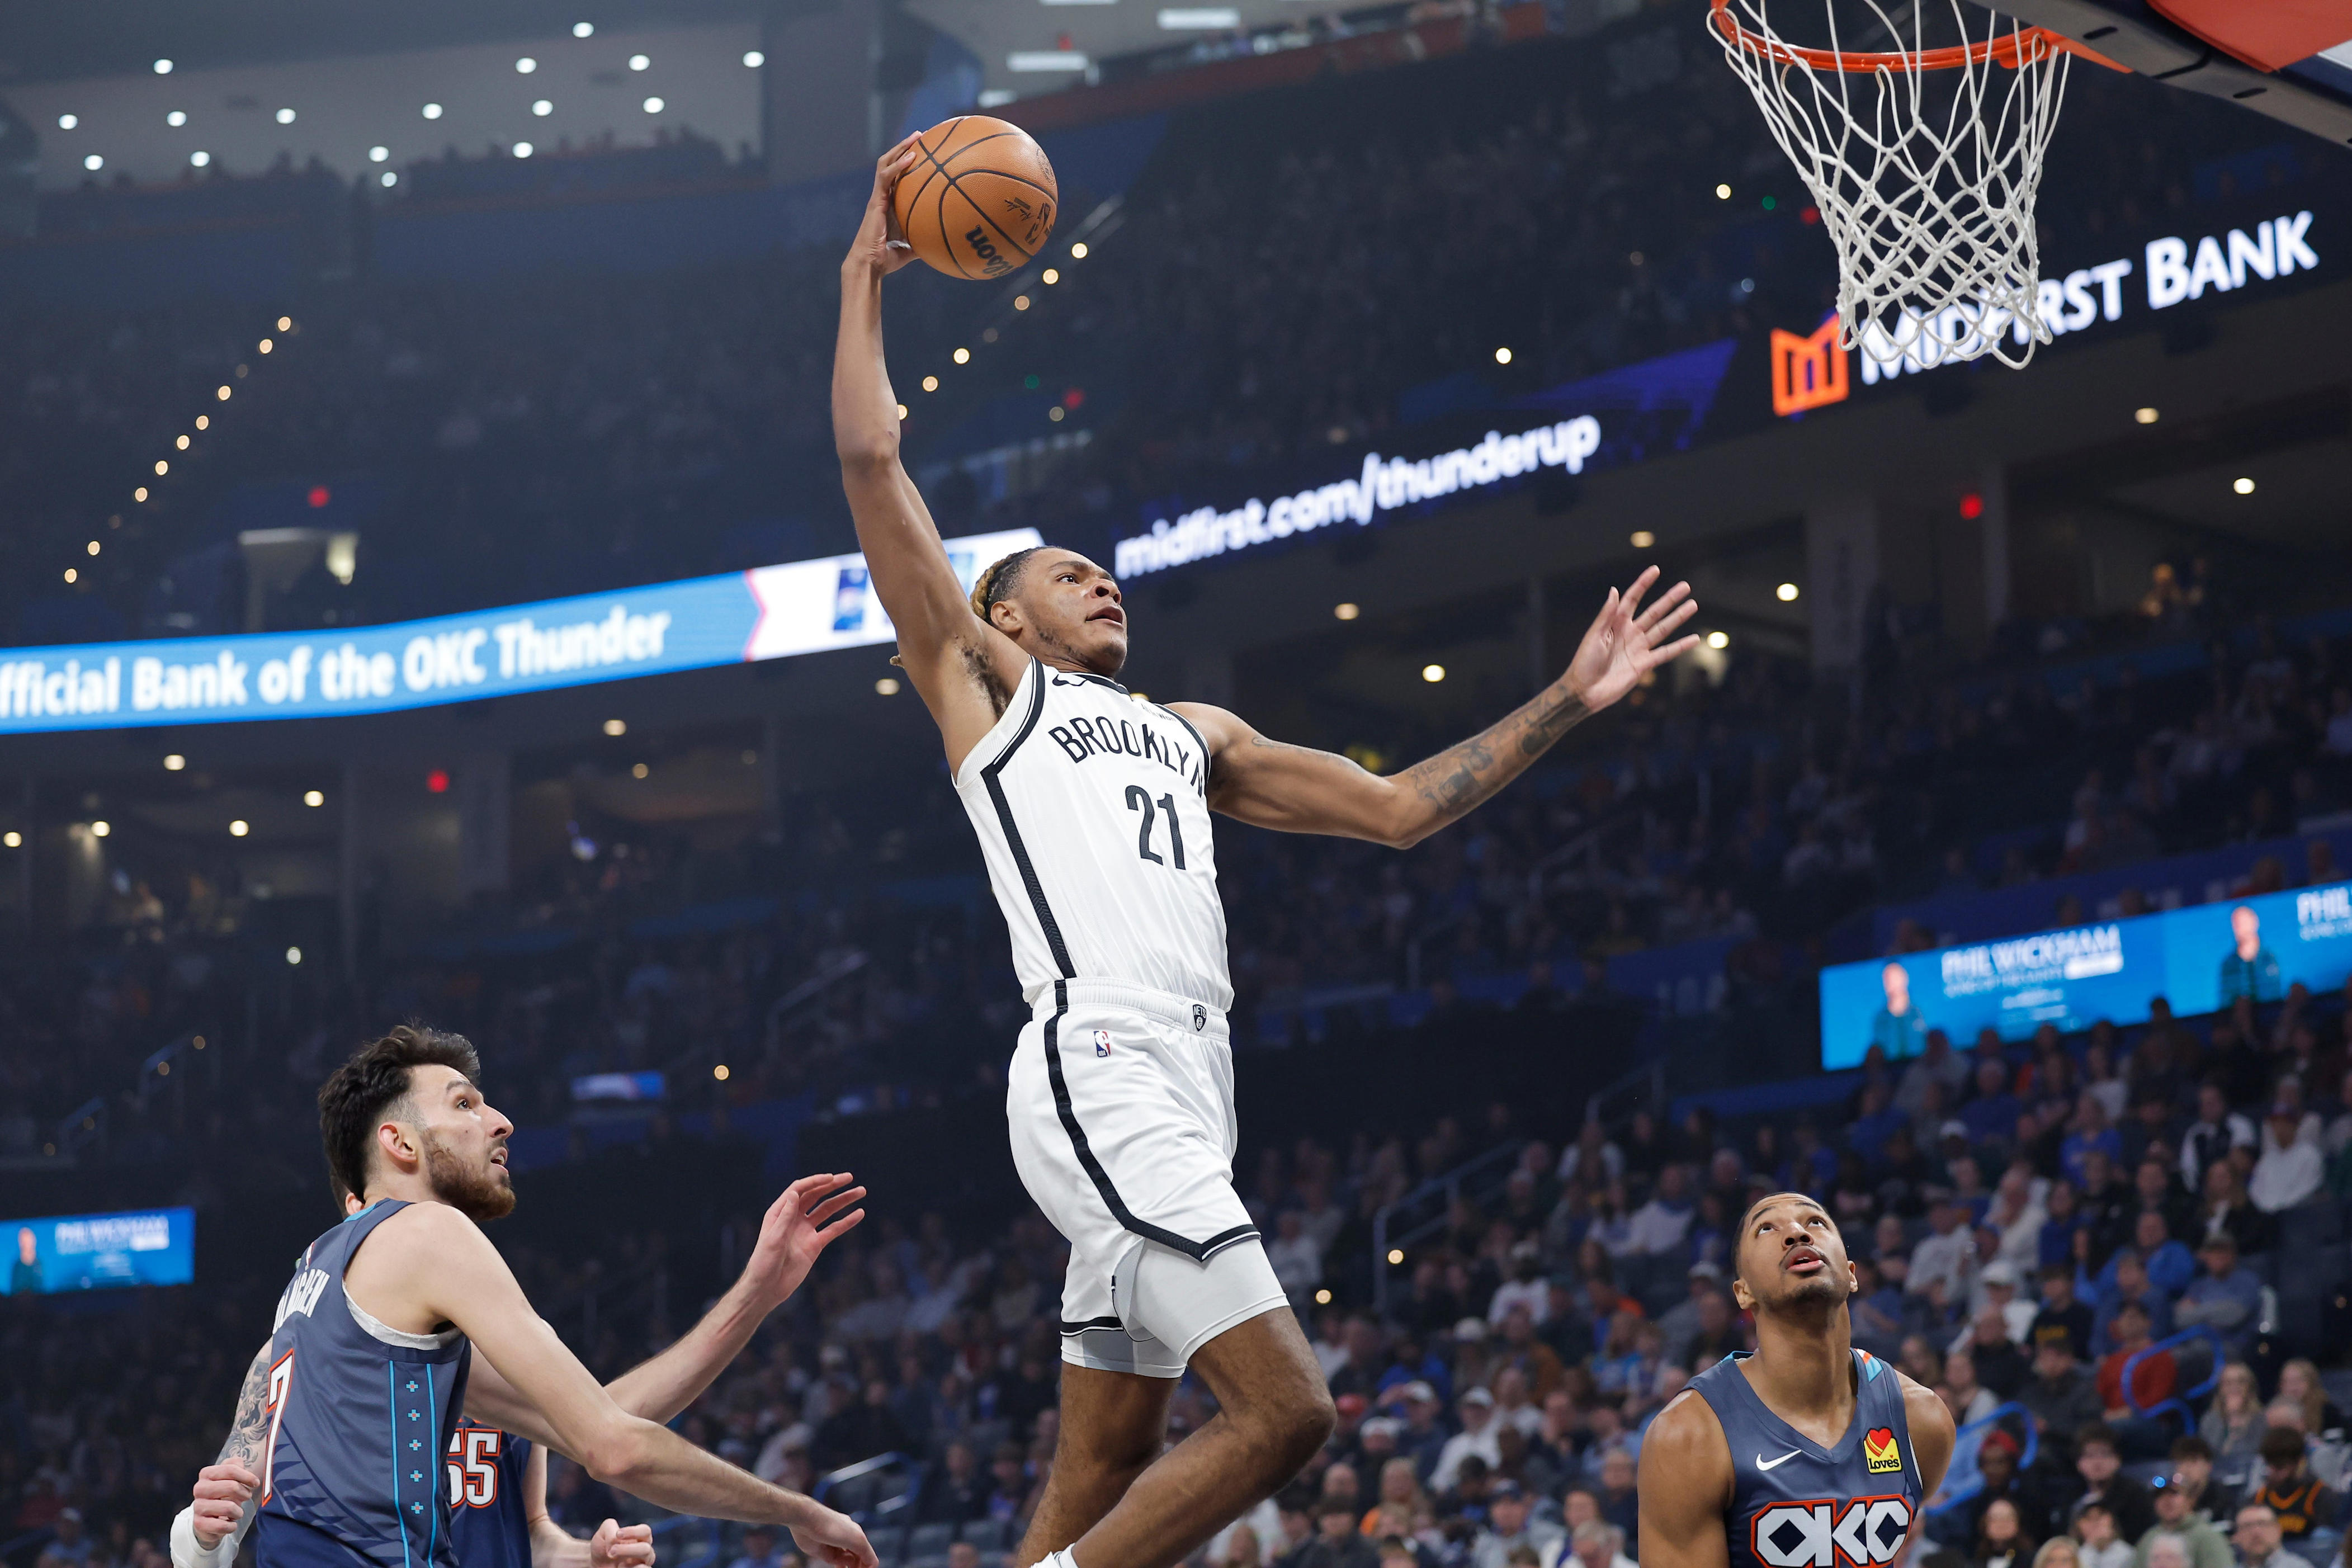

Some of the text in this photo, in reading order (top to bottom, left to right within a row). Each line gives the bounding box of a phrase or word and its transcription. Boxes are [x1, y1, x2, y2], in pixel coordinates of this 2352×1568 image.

[965, 224, 1014, 277] ilson
[2146, 210, 2319, 310] BANK
[1115, 414, 1600, 580] midfirst.com/thunderup
[133, 650, 247, 711] Bank
[258, 646, 312, 703] of
[320, 643, 395, 701] the
[404, 627, 487, 692] OKC
[494, 605, 670, 678] Thunder
[1049, 716, 1203, 799] BROOKLYN
[1125, 785, 1187, 871] 21
[1942, 945, 1995, 983] PHIL
[1193, 1005, 1206, 1019] NETS
[261, 1347, 295, 1508] 7
[1750, 1493, 1914, 1568] OKC
